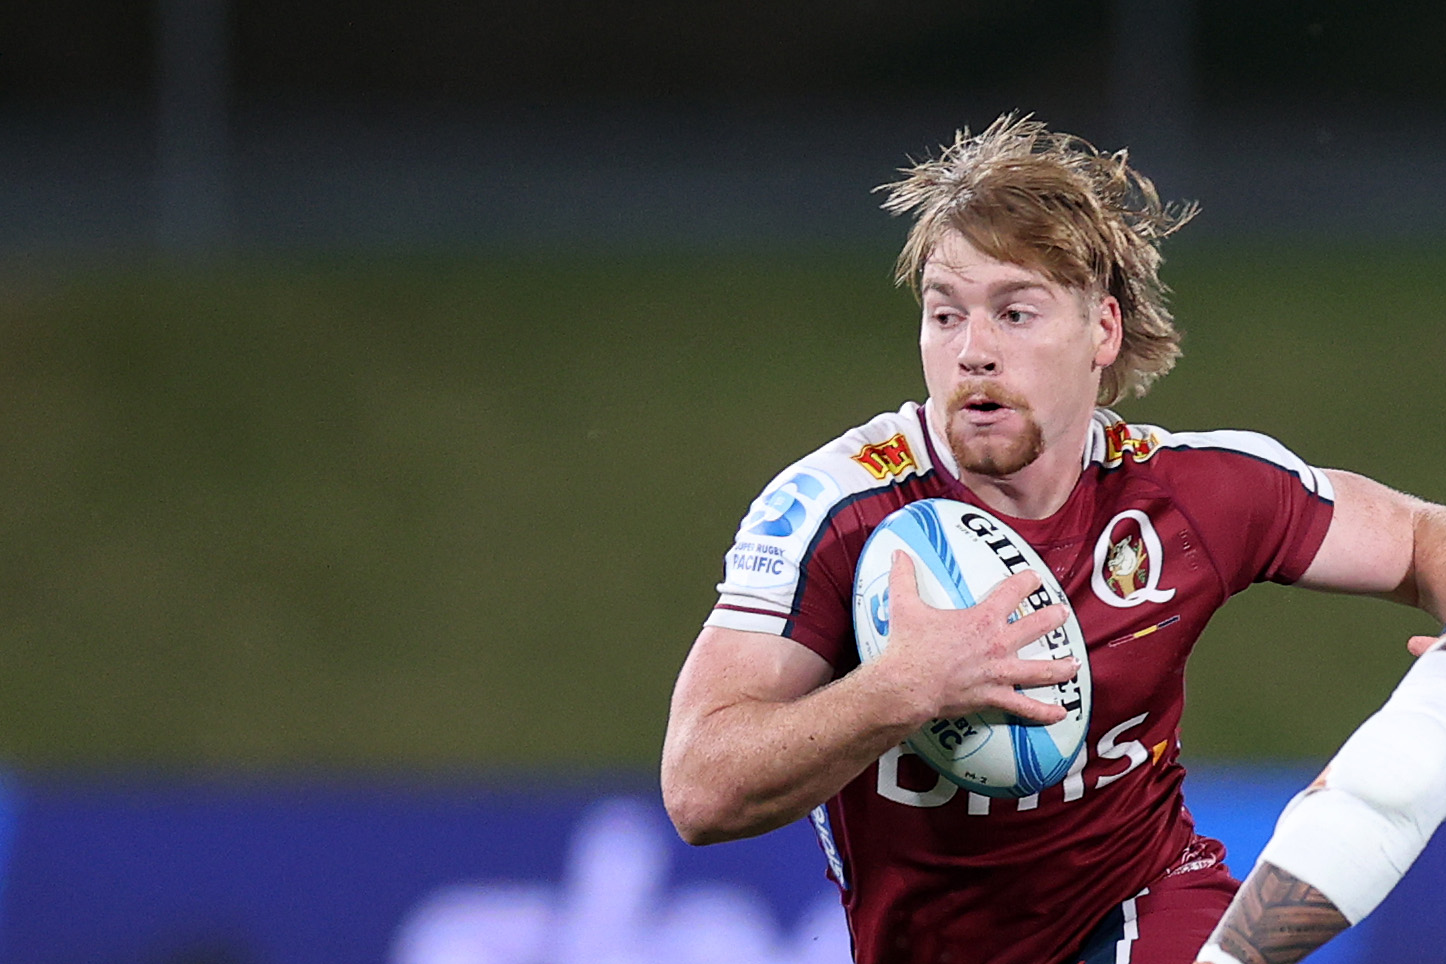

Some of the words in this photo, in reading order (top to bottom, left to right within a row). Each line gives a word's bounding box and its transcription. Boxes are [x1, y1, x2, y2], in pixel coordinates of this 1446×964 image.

[756, 544, 786, 557] RUGBY
[1091, 509, 1177, 608] Q
[732, 553, 785, 576] PACIFIC
